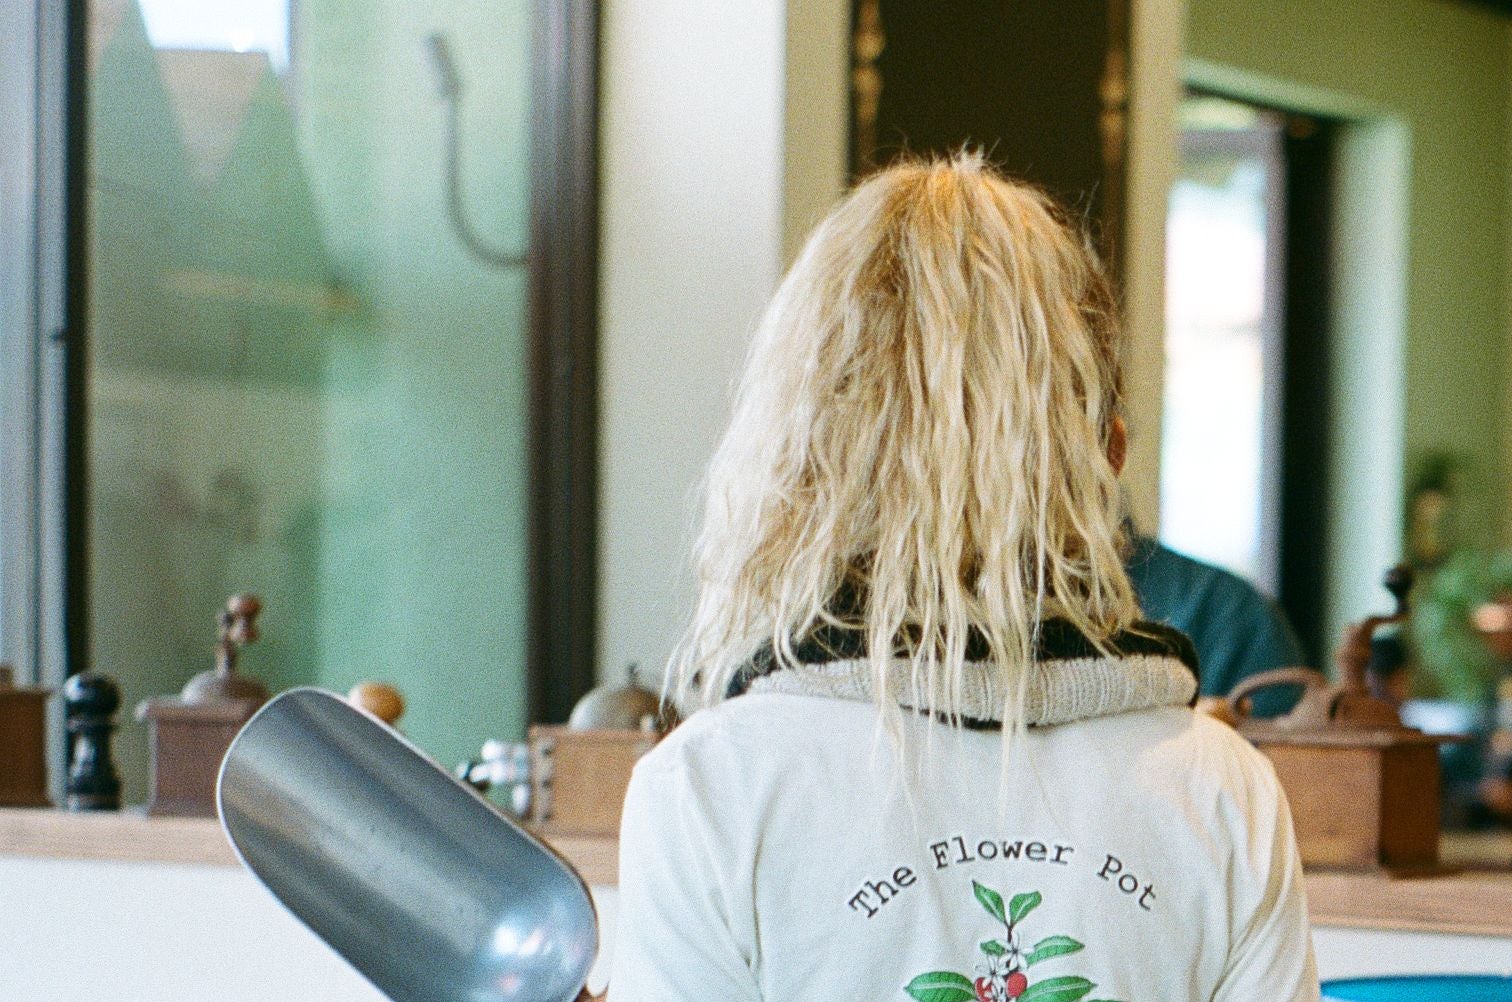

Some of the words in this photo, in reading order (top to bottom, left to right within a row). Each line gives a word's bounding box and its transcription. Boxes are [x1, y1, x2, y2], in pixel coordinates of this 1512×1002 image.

[848, 865, 918, 919] The
[928, 835, 1075, 871] Flower
[1096, 853, 1157, 912] Pot
